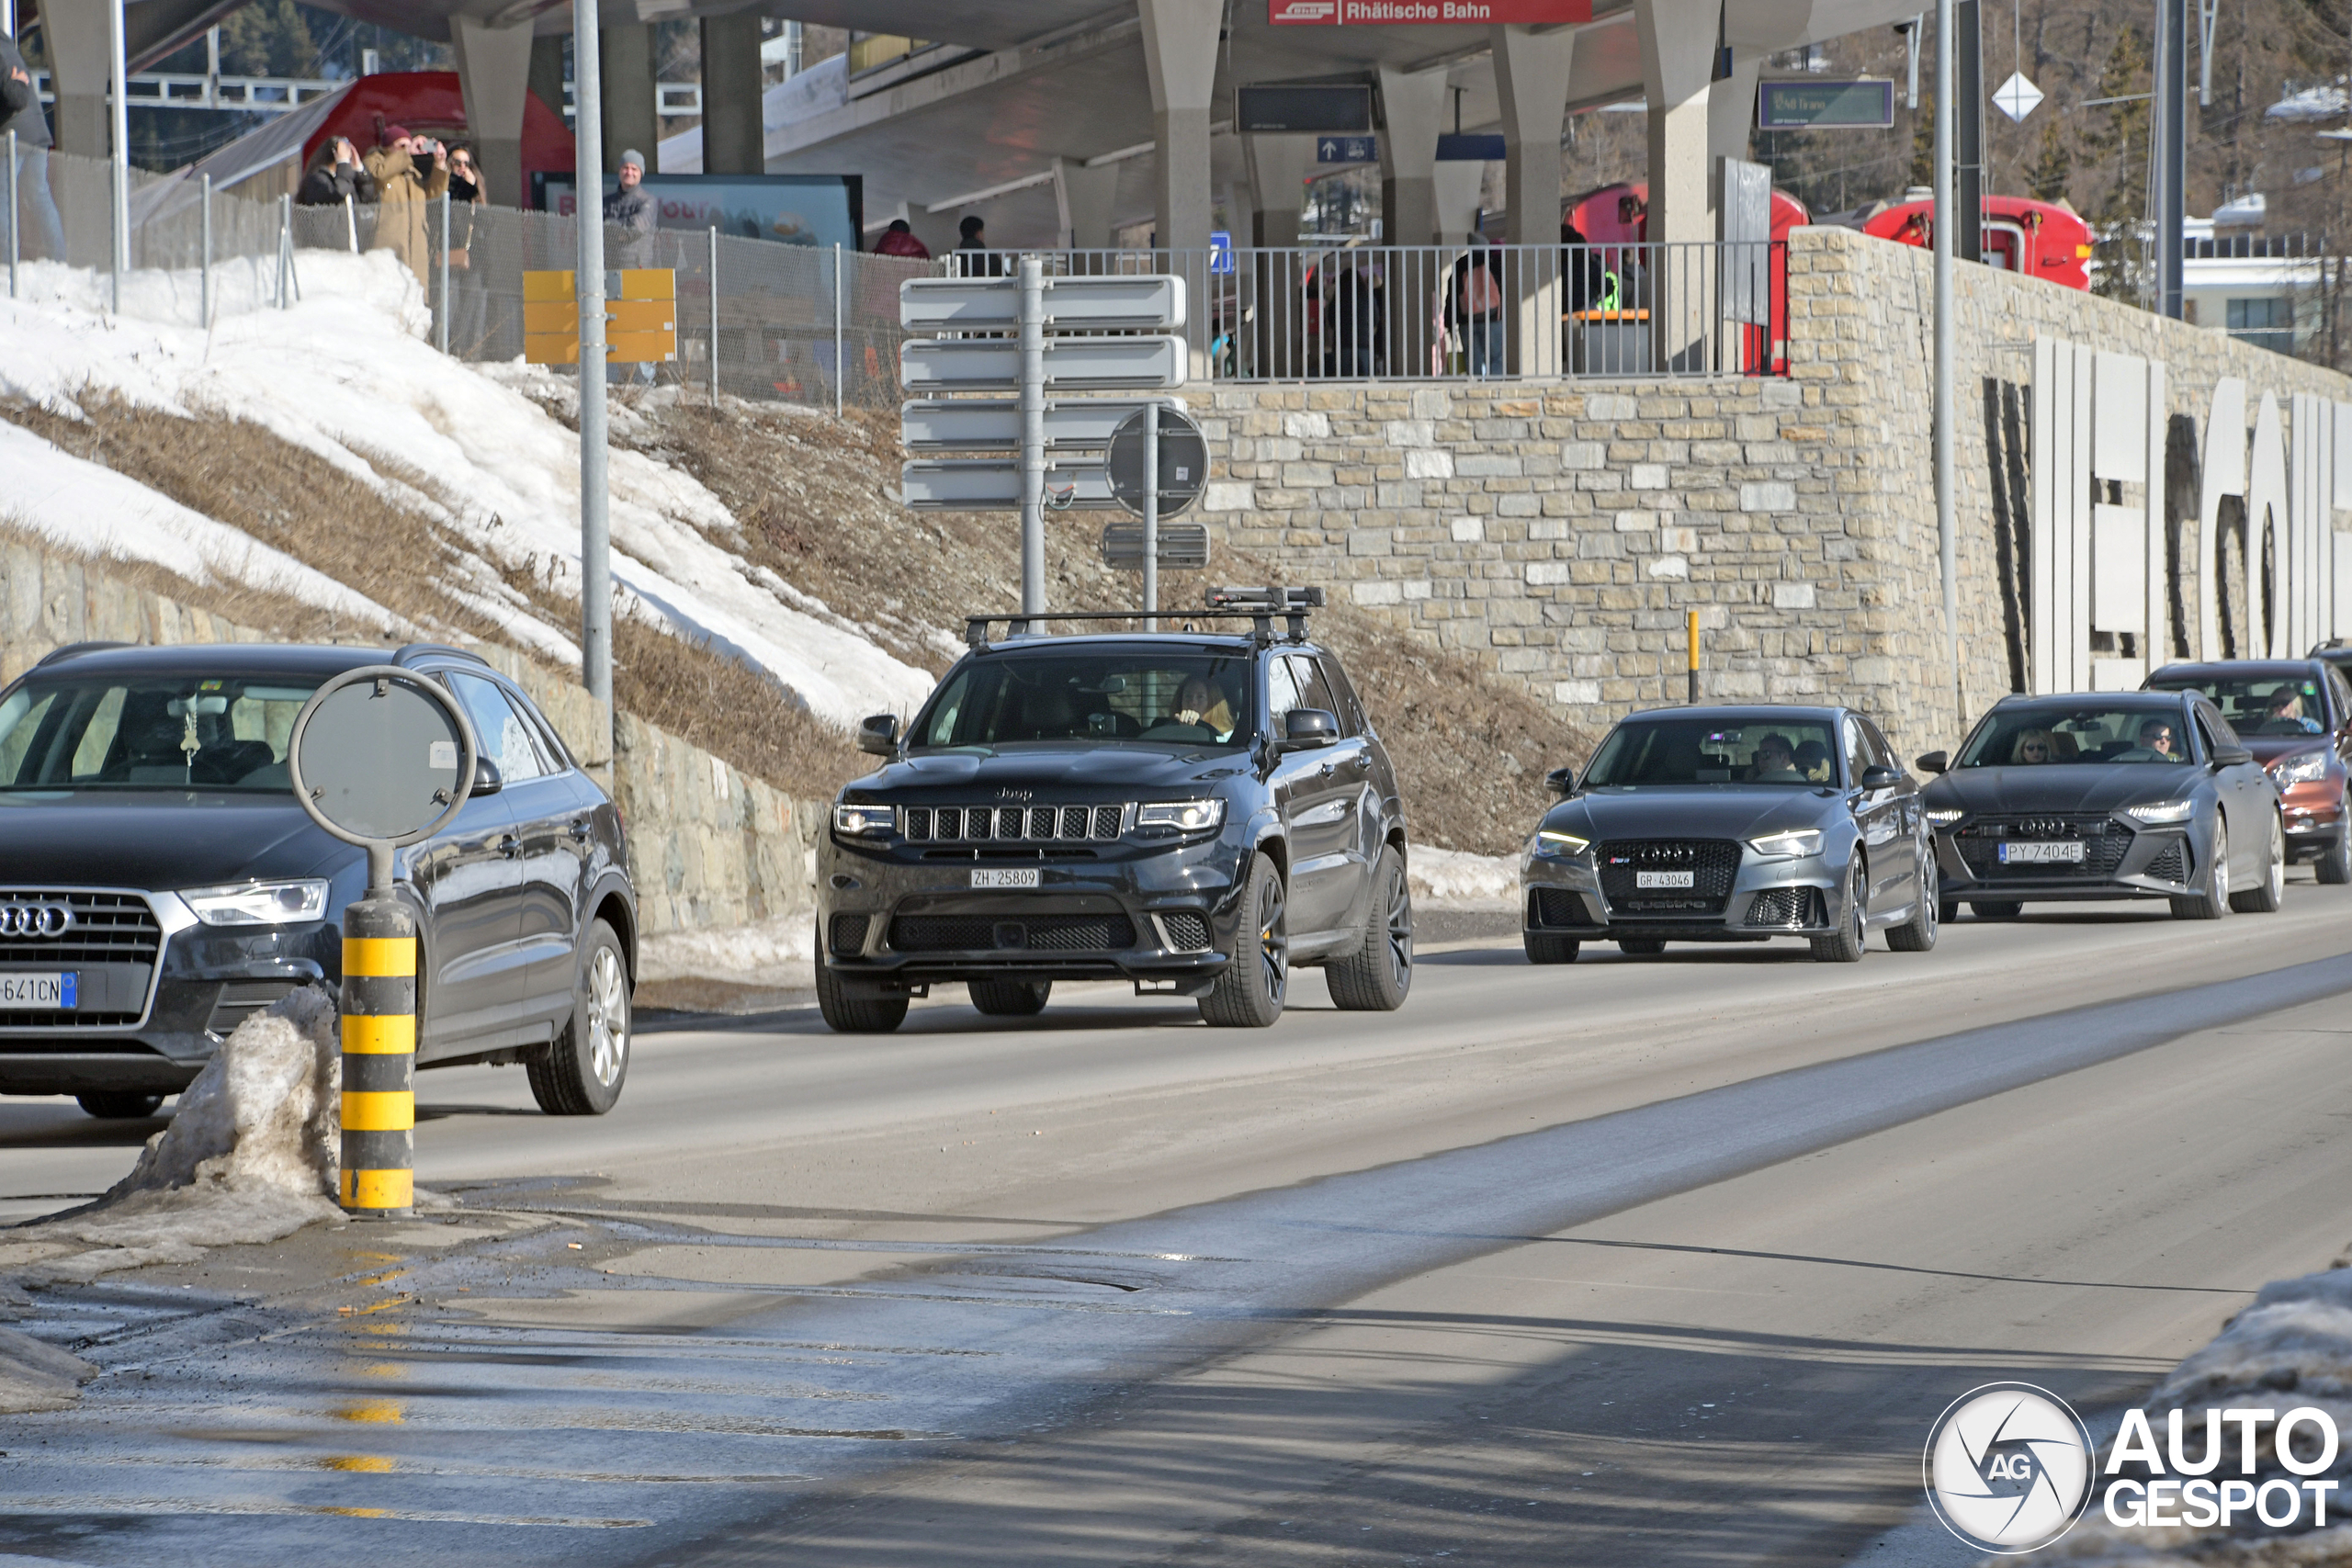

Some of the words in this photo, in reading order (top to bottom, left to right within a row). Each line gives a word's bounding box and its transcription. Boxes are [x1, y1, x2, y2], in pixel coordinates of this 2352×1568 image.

[1346, 2, 1438, 19] Rhätische
[1442, 2, 1490, 18] Bahn
[994, 786, 1033, 802] Jeep
[1627, 900, 1707, 911] quattro
